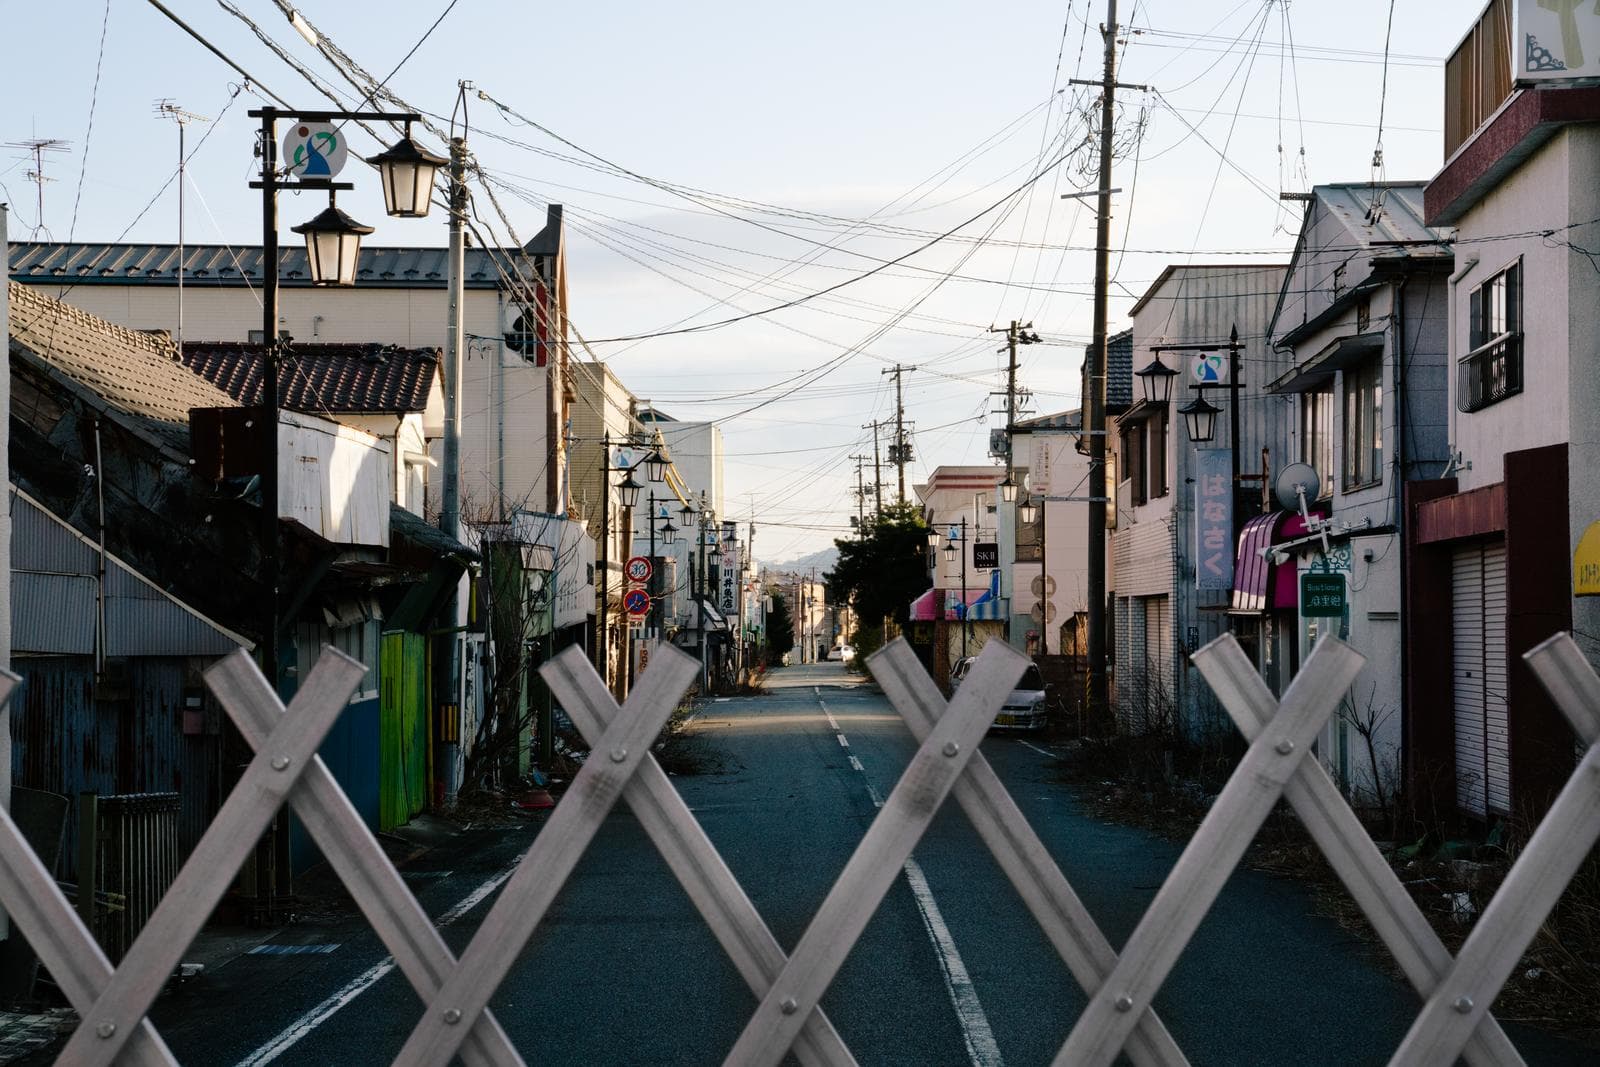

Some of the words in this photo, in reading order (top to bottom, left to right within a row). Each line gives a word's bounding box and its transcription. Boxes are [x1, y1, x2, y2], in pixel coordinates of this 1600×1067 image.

[1200, 473, 1226, 576] はなさく
[631, 564, 646, 576] 30
